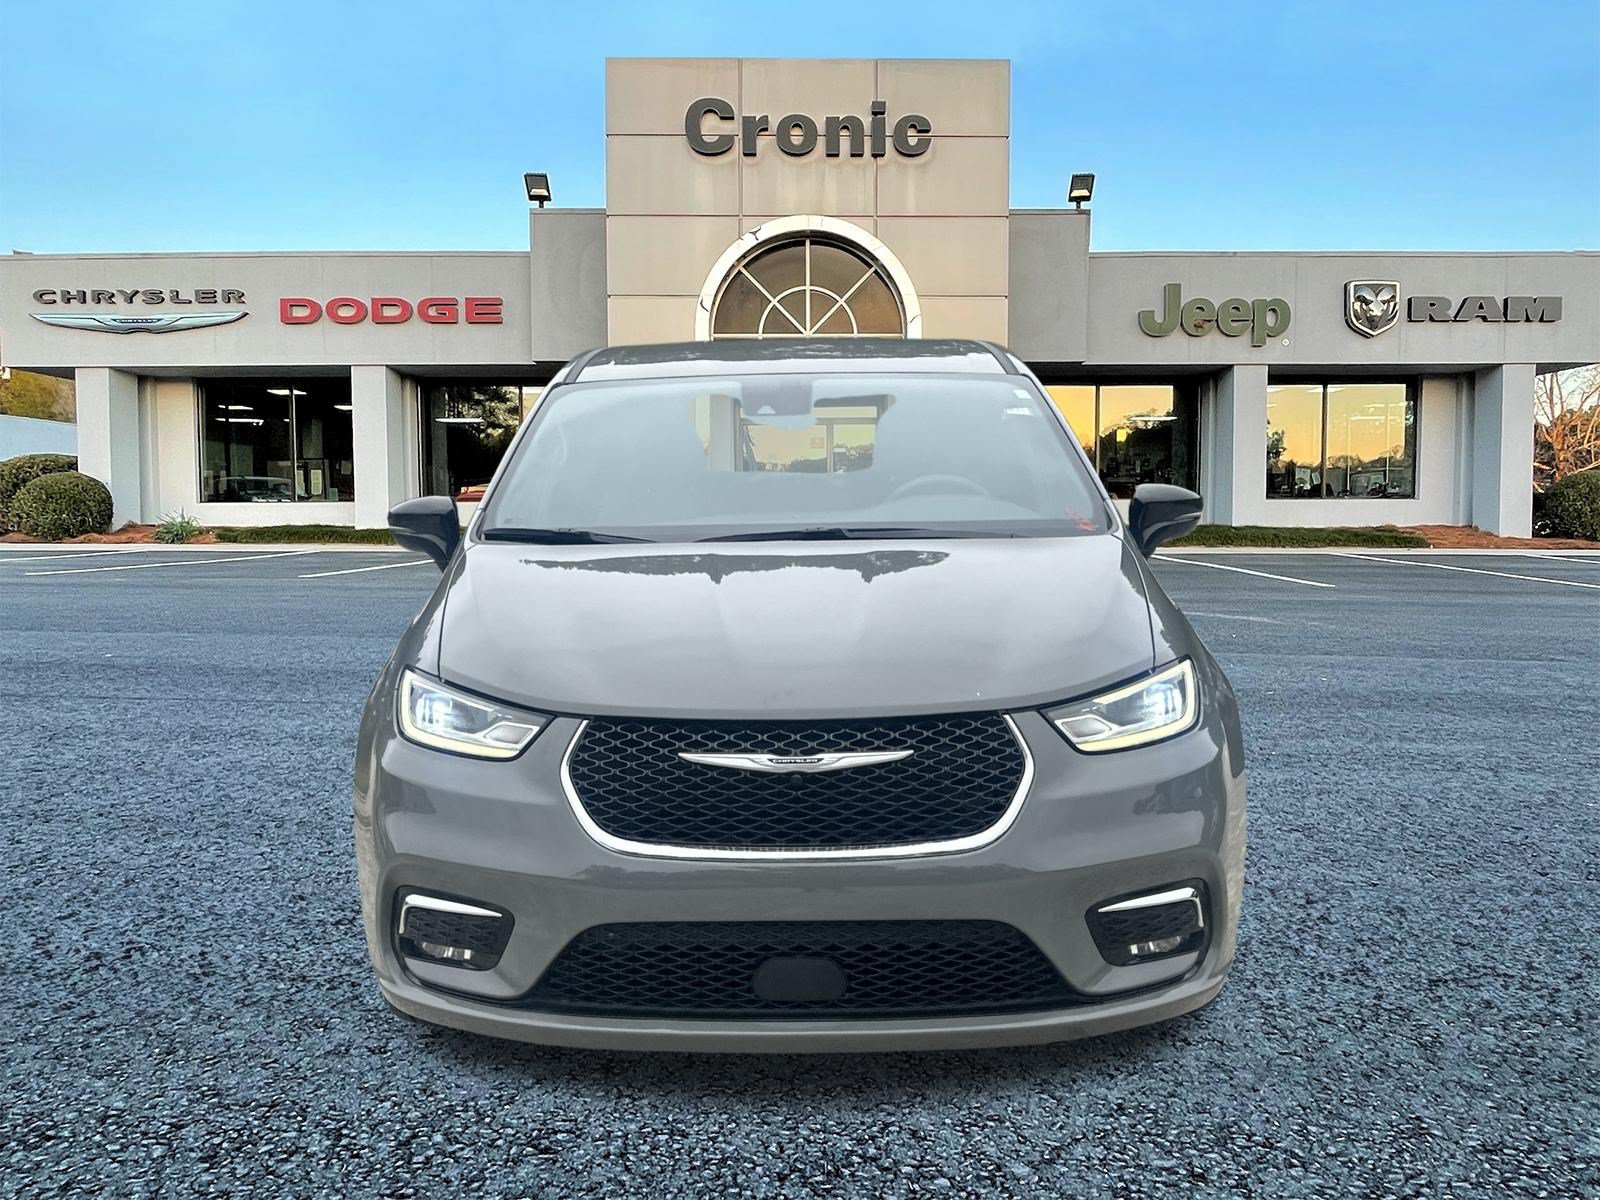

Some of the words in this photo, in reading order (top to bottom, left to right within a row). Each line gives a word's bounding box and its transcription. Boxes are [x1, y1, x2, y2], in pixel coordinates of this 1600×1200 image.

[685, 97, 932, 157] Cronic
[32, 288, 246, 305] CHRYSLER
[1407, 295, 1563, 323] RAM
[279, 297, 504, 325] DODGE
[1138, 283, 1292, 348] Jeep
